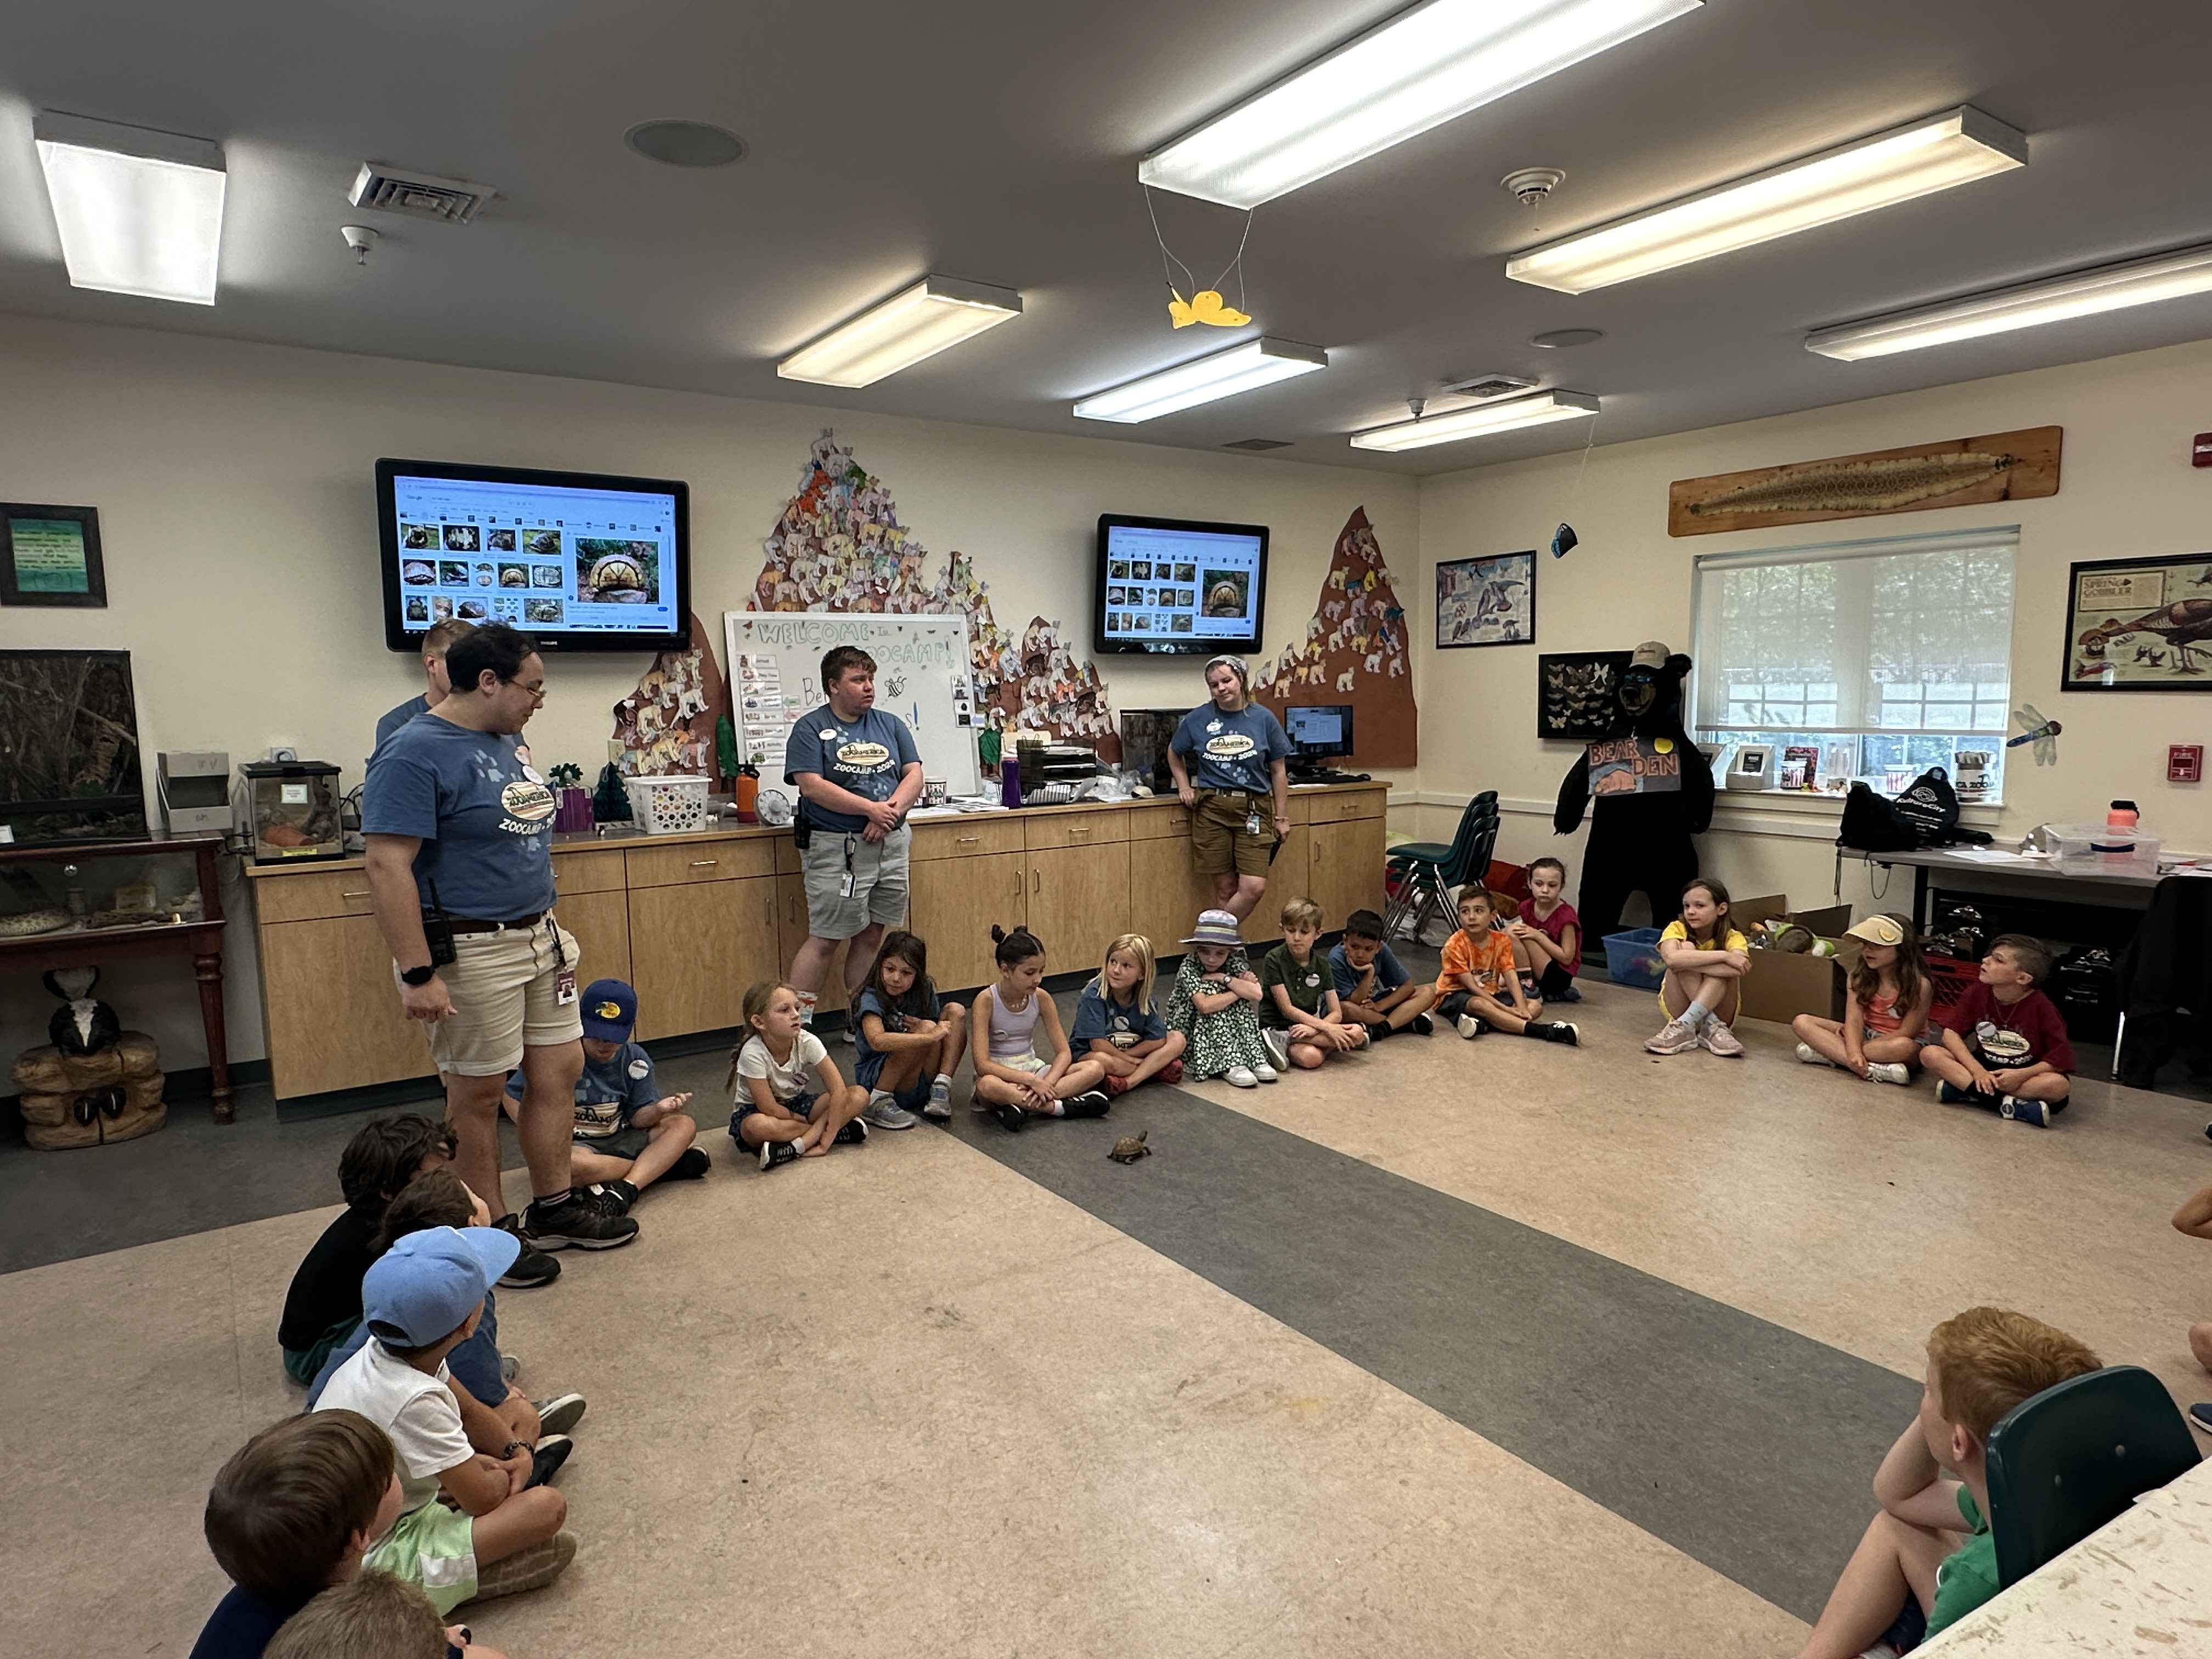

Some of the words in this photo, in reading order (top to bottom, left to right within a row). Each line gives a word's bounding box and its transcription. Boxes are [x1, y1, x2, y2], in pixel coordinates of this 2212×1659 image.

[758, 623, 870, 644] WELCOME
[858, 636, 955, 669] OOCAMP!
[1202, 752, 1233, 761] ZOOCAMP
[1589, 740, 1640, 766] BEAR
[833, 763, 872, 775] ZOOCAMP
[1632, 754, 1679, 777] DEN
[498, 818, 542, 835] ZOOCAMP
